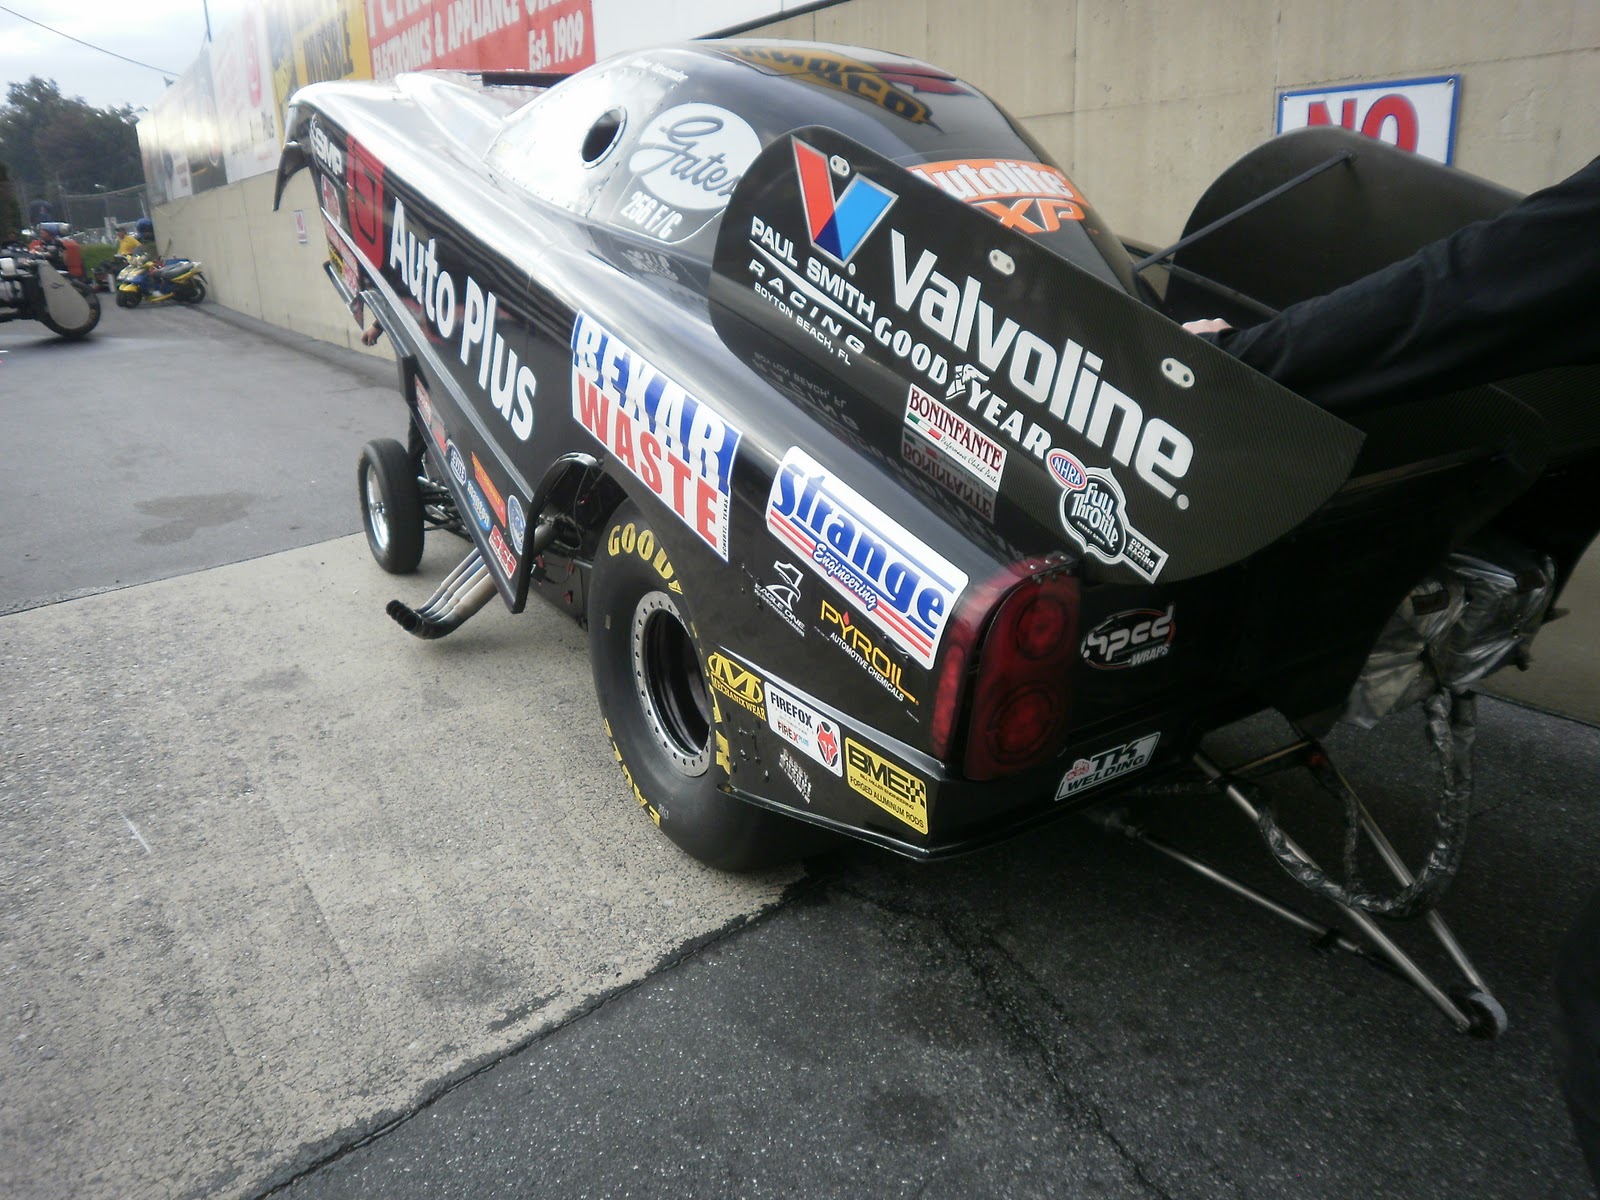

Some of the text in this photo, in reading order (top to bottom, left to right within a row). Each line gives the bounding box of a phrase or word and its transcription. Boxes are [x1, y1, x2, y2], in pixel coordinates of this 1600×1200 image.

[372, 17, 434, 80] ELECTRONICS
[434, 11, 444, 57] &
[447, 0, 520, 51] APPLIANCE
[529, 9, 584, 72] Est. 1909
[972, 198, 1086, 234] XP
[751, 215, 876, 322] PAUL SMITH
[390, 196, 455, 338] Auto
[460, 276, 537, 441] Plus
[749, 258, 866, 354] RACING
[797, 316, 834, 354] BEACH,
[838, 347, 851, 366] FL
[891, 228, 1194, 499] Valvoline
[874, 316, 1052, 460] GOOD YEAR
[578, 372, 718, 549] WASTE
[909, 388, 1004, 472] BONINFANTE
[1051, 457, 1081, 485] NHRA
[772, 463, 945, 630] Strange
[812, 541, 877, 611] Engineering
[1127, 544, 1156, 569] RACING
[1131, 538, 1151, 556] DRAG
[754, 583, 784, 611] EAGLE
[785, 609, 806, 631] ONE
[821, 600, 917, 703] PYROIL
[830, 632, 905, 702] AUTOMOTIVE CHEMICALS
[1131, 644, 1170, 667] WRAPS
[711, 674, 767, 721] MECHANIX WEAR
[770, 691, 813, 728] FIREFOX
[1067, 754, 1144, 792] WELDING
[1091, 741, 1138, 772] TK
[850, 775, 924, 829] FORGED ALUMINUM RODS
